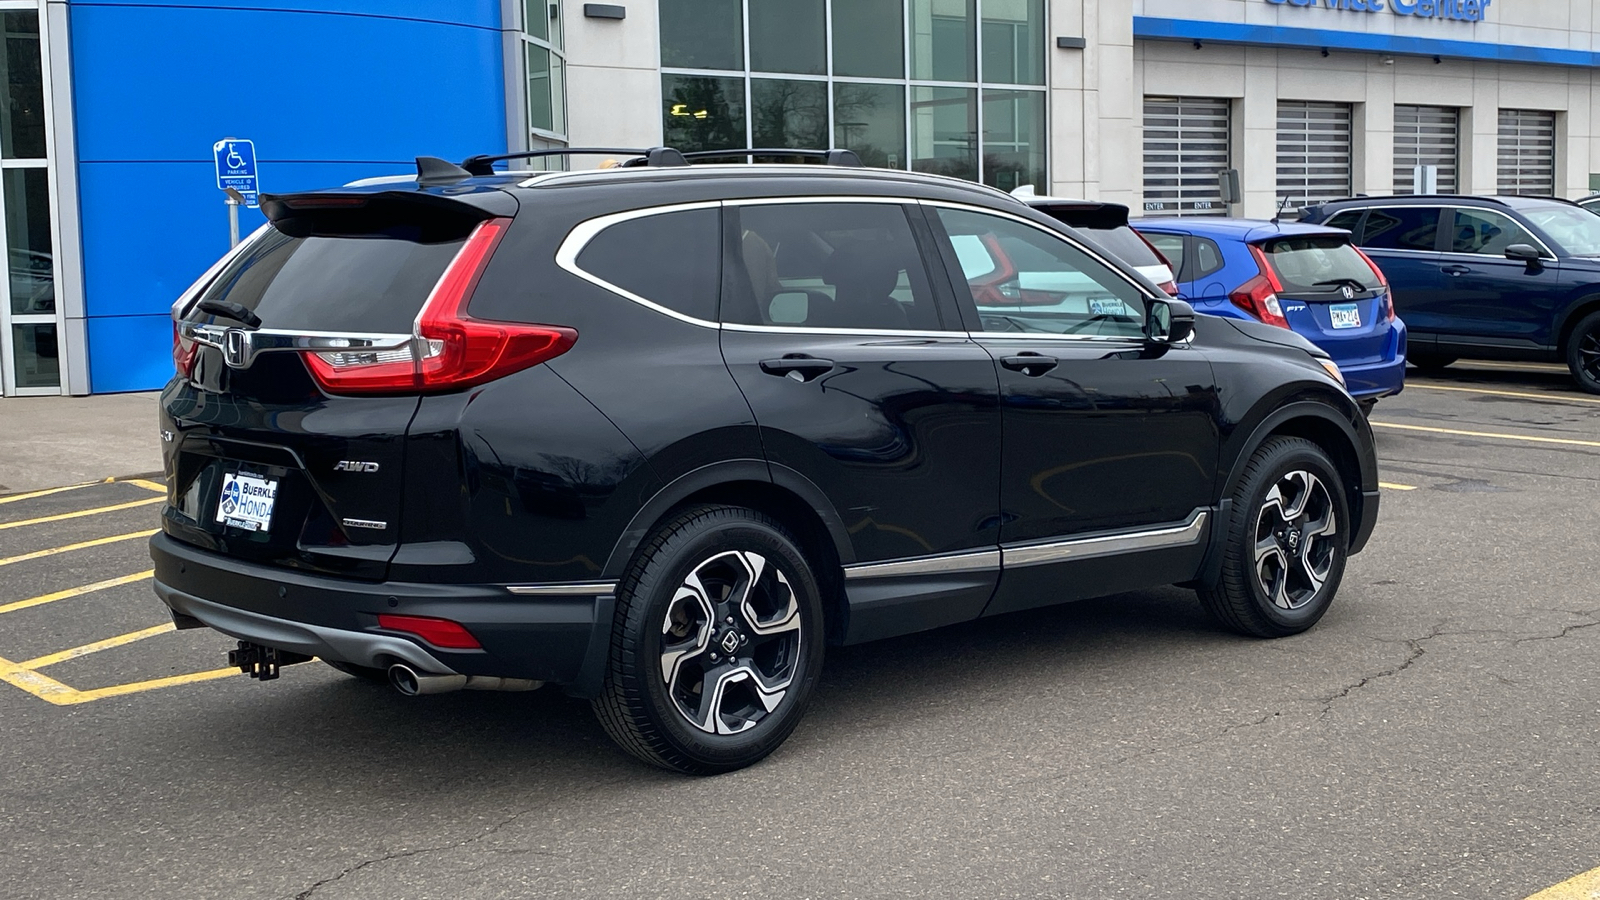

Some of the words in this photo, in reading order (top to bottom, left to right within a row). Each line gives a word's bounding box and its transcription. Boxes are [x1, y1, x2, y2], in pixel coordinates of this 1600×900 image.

[1266, 0, 1384, 12] vice
[1390, 0, 1490, 21] Center
[1145, 202, 1164, 210] ENTER
[1194, 201, 1212, 210] ENTER
[333, 460, 380, 473] AWD
[242, 482, 276, 499] BUERKLE
[239, 495, 273, 518] HONDA
